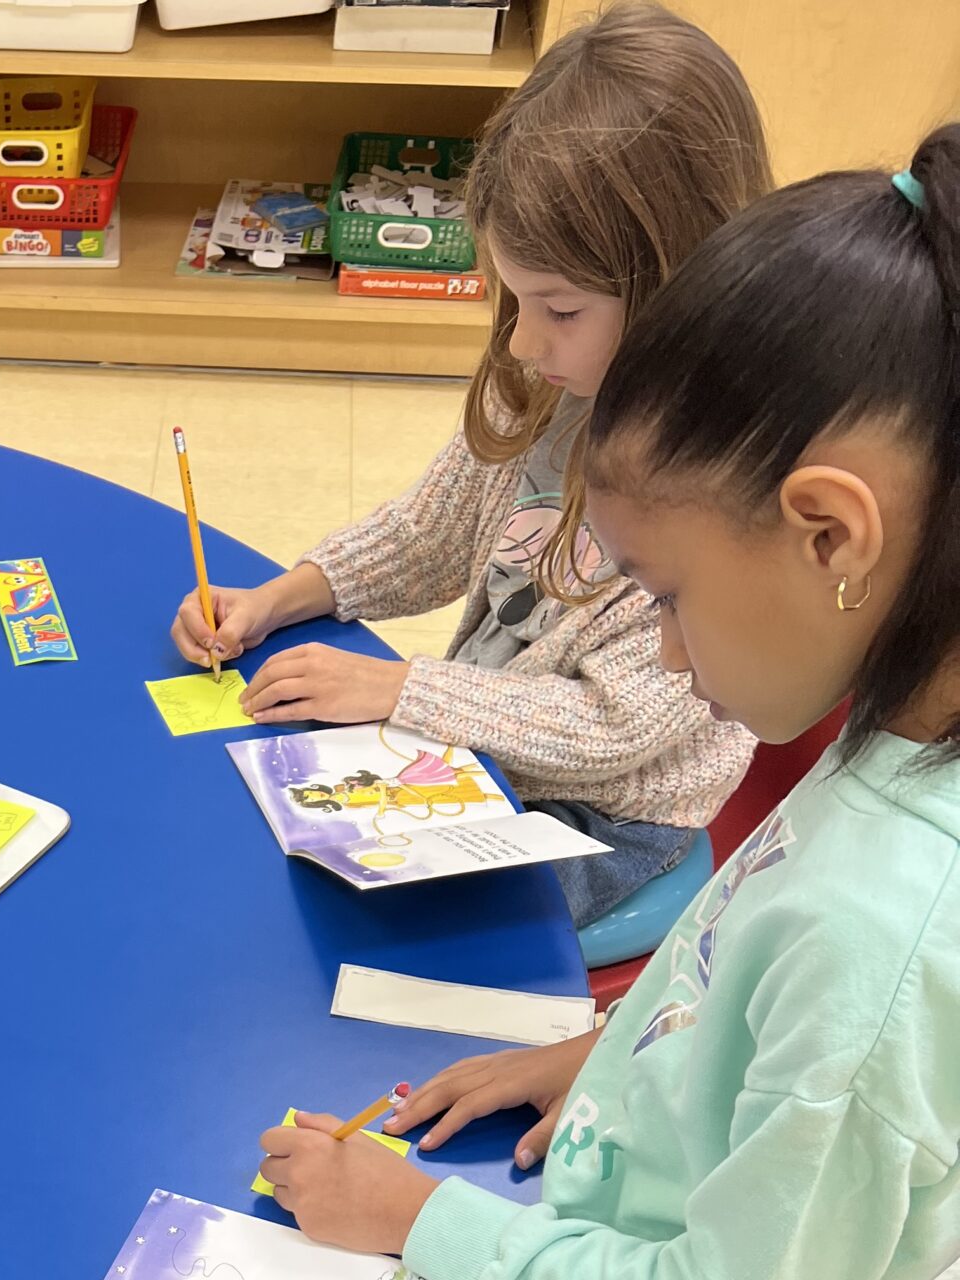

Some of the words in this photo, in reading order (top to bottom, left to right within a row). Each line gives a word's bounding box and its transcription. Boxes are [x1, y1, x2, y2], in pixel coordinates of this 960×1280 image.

[5, 240, 49, 253] BINGO!
[361, 279, 398, 290] alphabet
[399, 280, 419, 289] floor
[418, 282, 445, 291] puzzle
[9, 619, 33, 653] Student
[24, 614, 69, 654] STAR
